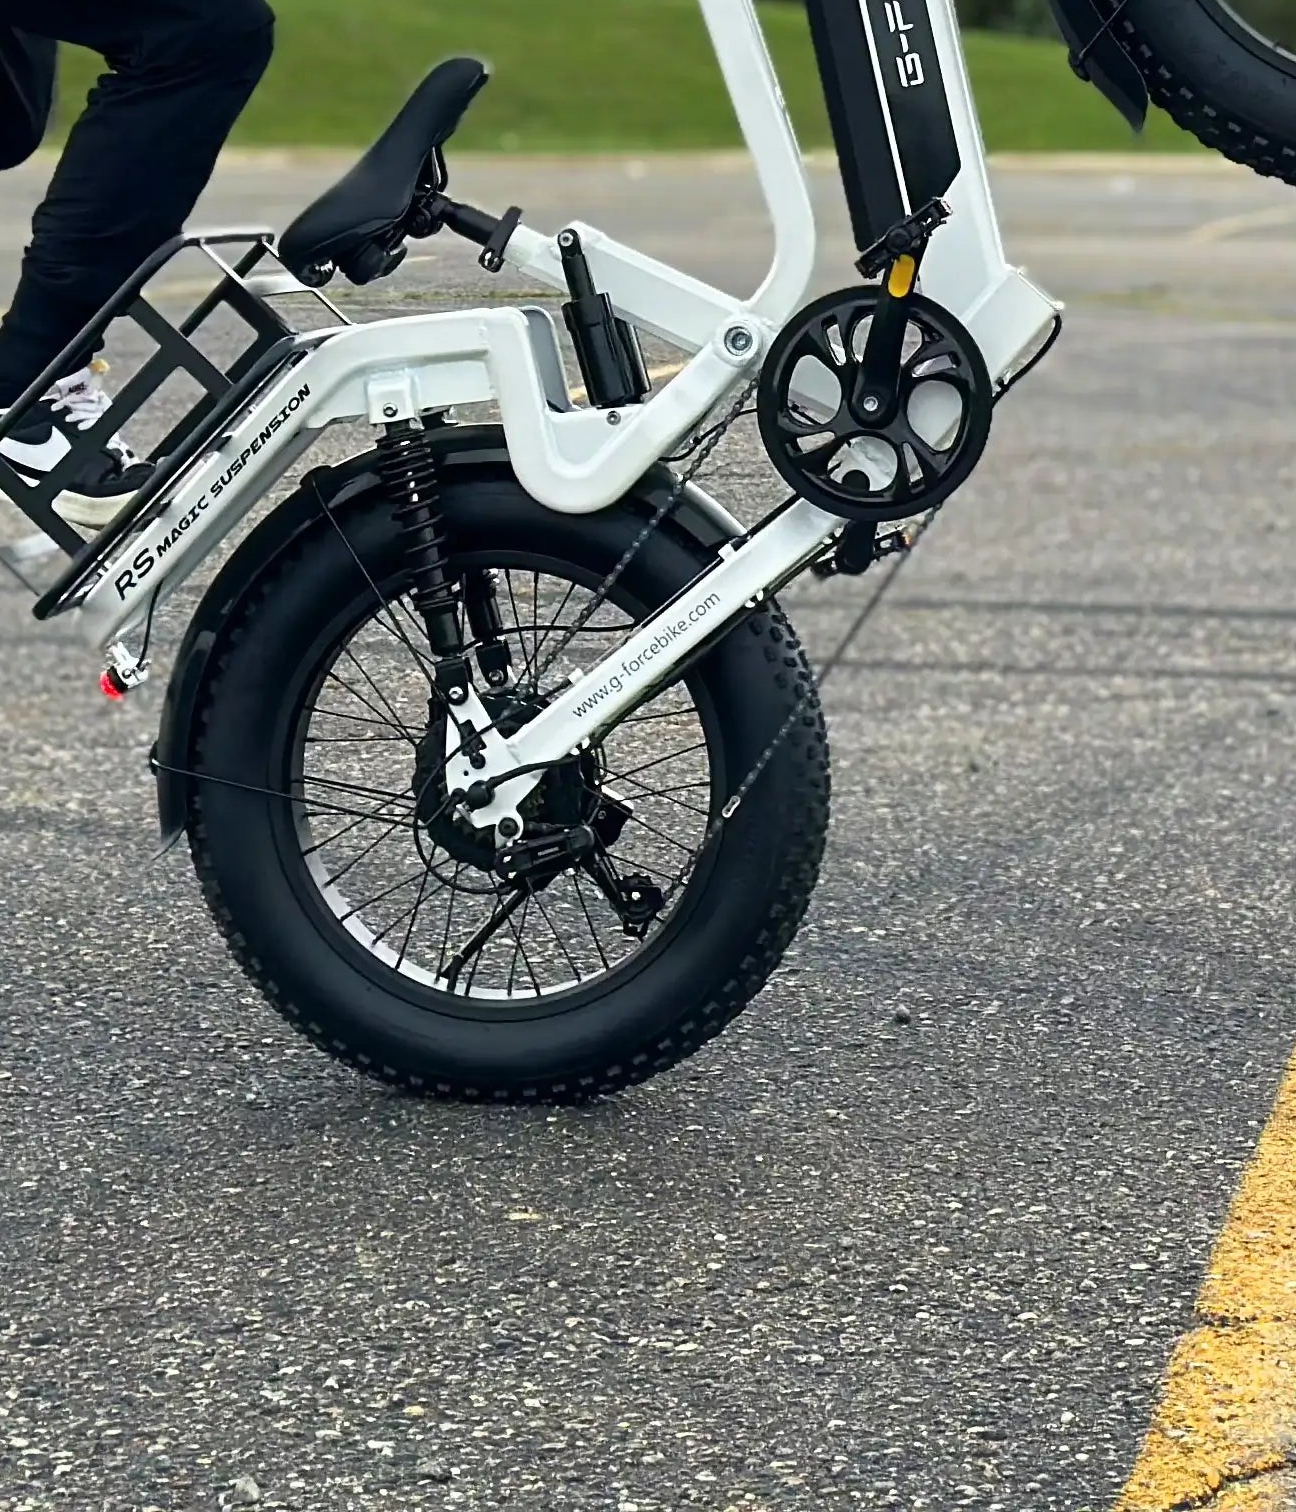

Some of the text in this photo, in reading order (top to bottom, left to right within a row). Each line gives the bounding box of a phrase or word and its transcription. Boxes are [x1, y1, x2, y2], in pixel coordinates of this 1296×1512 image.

[114, 384, 311, 600] RS MAGIC SUSPENSION
[572, 592, 721, 719] www.g-forcebike.com
